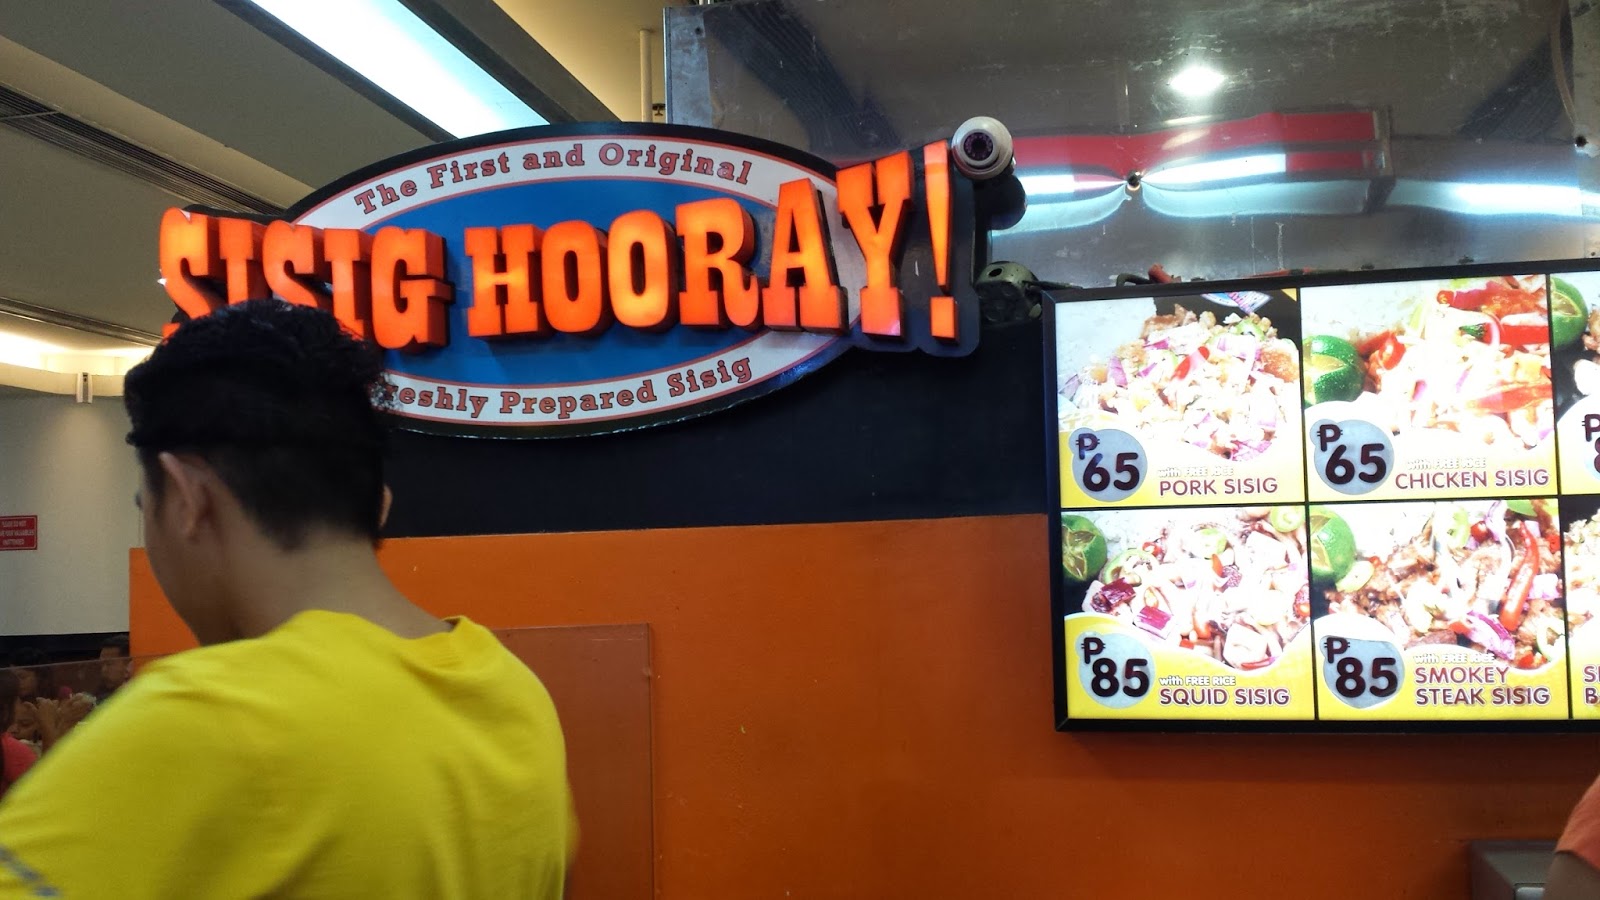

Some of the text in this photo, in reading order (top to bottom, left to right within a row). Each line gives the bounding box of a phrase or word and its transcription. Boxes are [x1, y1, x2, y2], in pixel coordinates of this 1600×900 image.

[354, 142, 753, 215] The First and Original
[464, 139, 959, 342] HOORAY!
[380, 357, 752, 419] reshly Prepared Sisig
[1159, 477, 1279, 497] PORK SISIG
[1395, 468, 1550, 490] CHICKEN SISIG
[1413, 653, 1439, 664] with
[1159, 676, 1236, 686] with FREE RICE
[1414, 666, 1510, 684] SMOKEY
[1160, 688, 1290, 706] SQUID SISIG
[1416, 687, 1551, 706] STEAK SISIG
